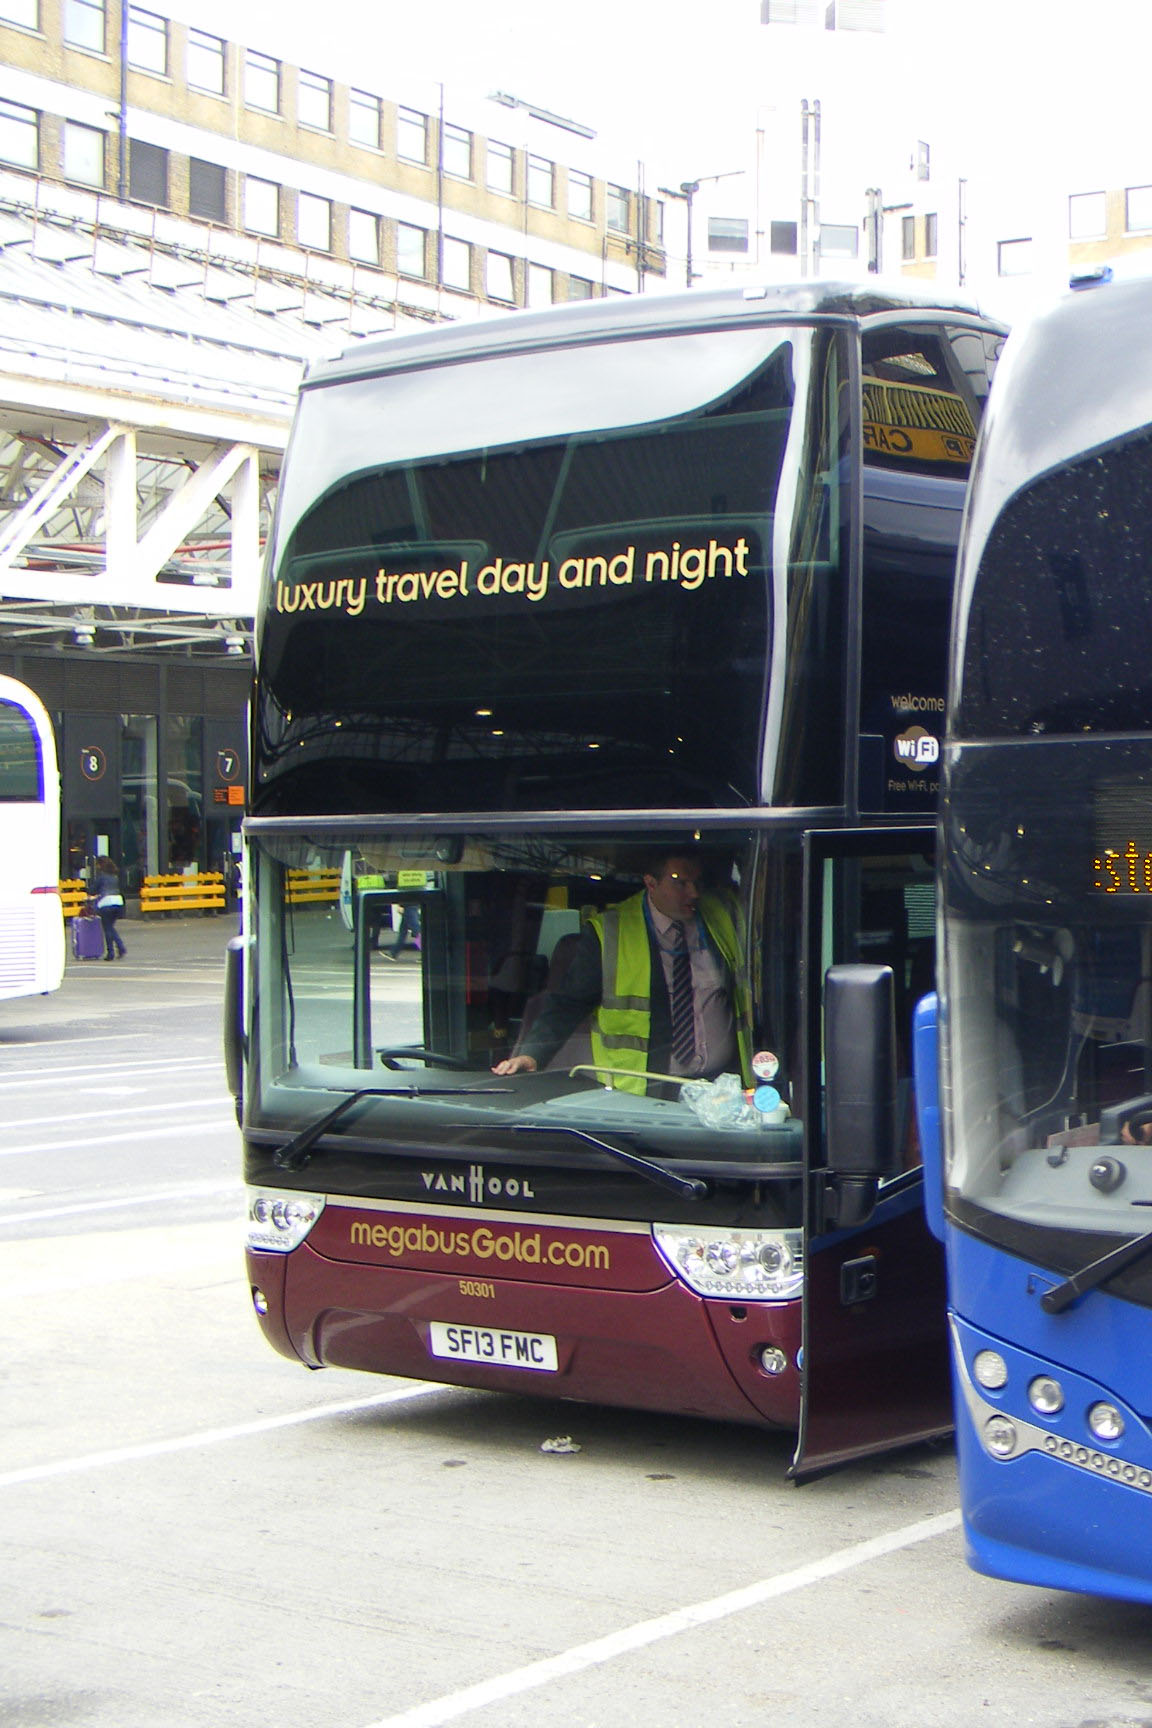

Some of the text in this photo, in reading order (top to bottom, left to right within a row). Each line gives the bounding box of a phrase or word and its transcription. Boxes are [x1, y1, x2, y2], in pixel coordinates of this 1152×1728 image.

[276, 537, 749, 617] luxury travel day and night
[891, 693, 945, 712] welcome
[89, 755, 98, 772] 8
[224, 757, 233, 773] 7
[350, 1220, 610, 1271] megabusGold.com
[459, 1280, 496, 1299] 50301
[447, 1328, 545, 1363] SF13 FMC
